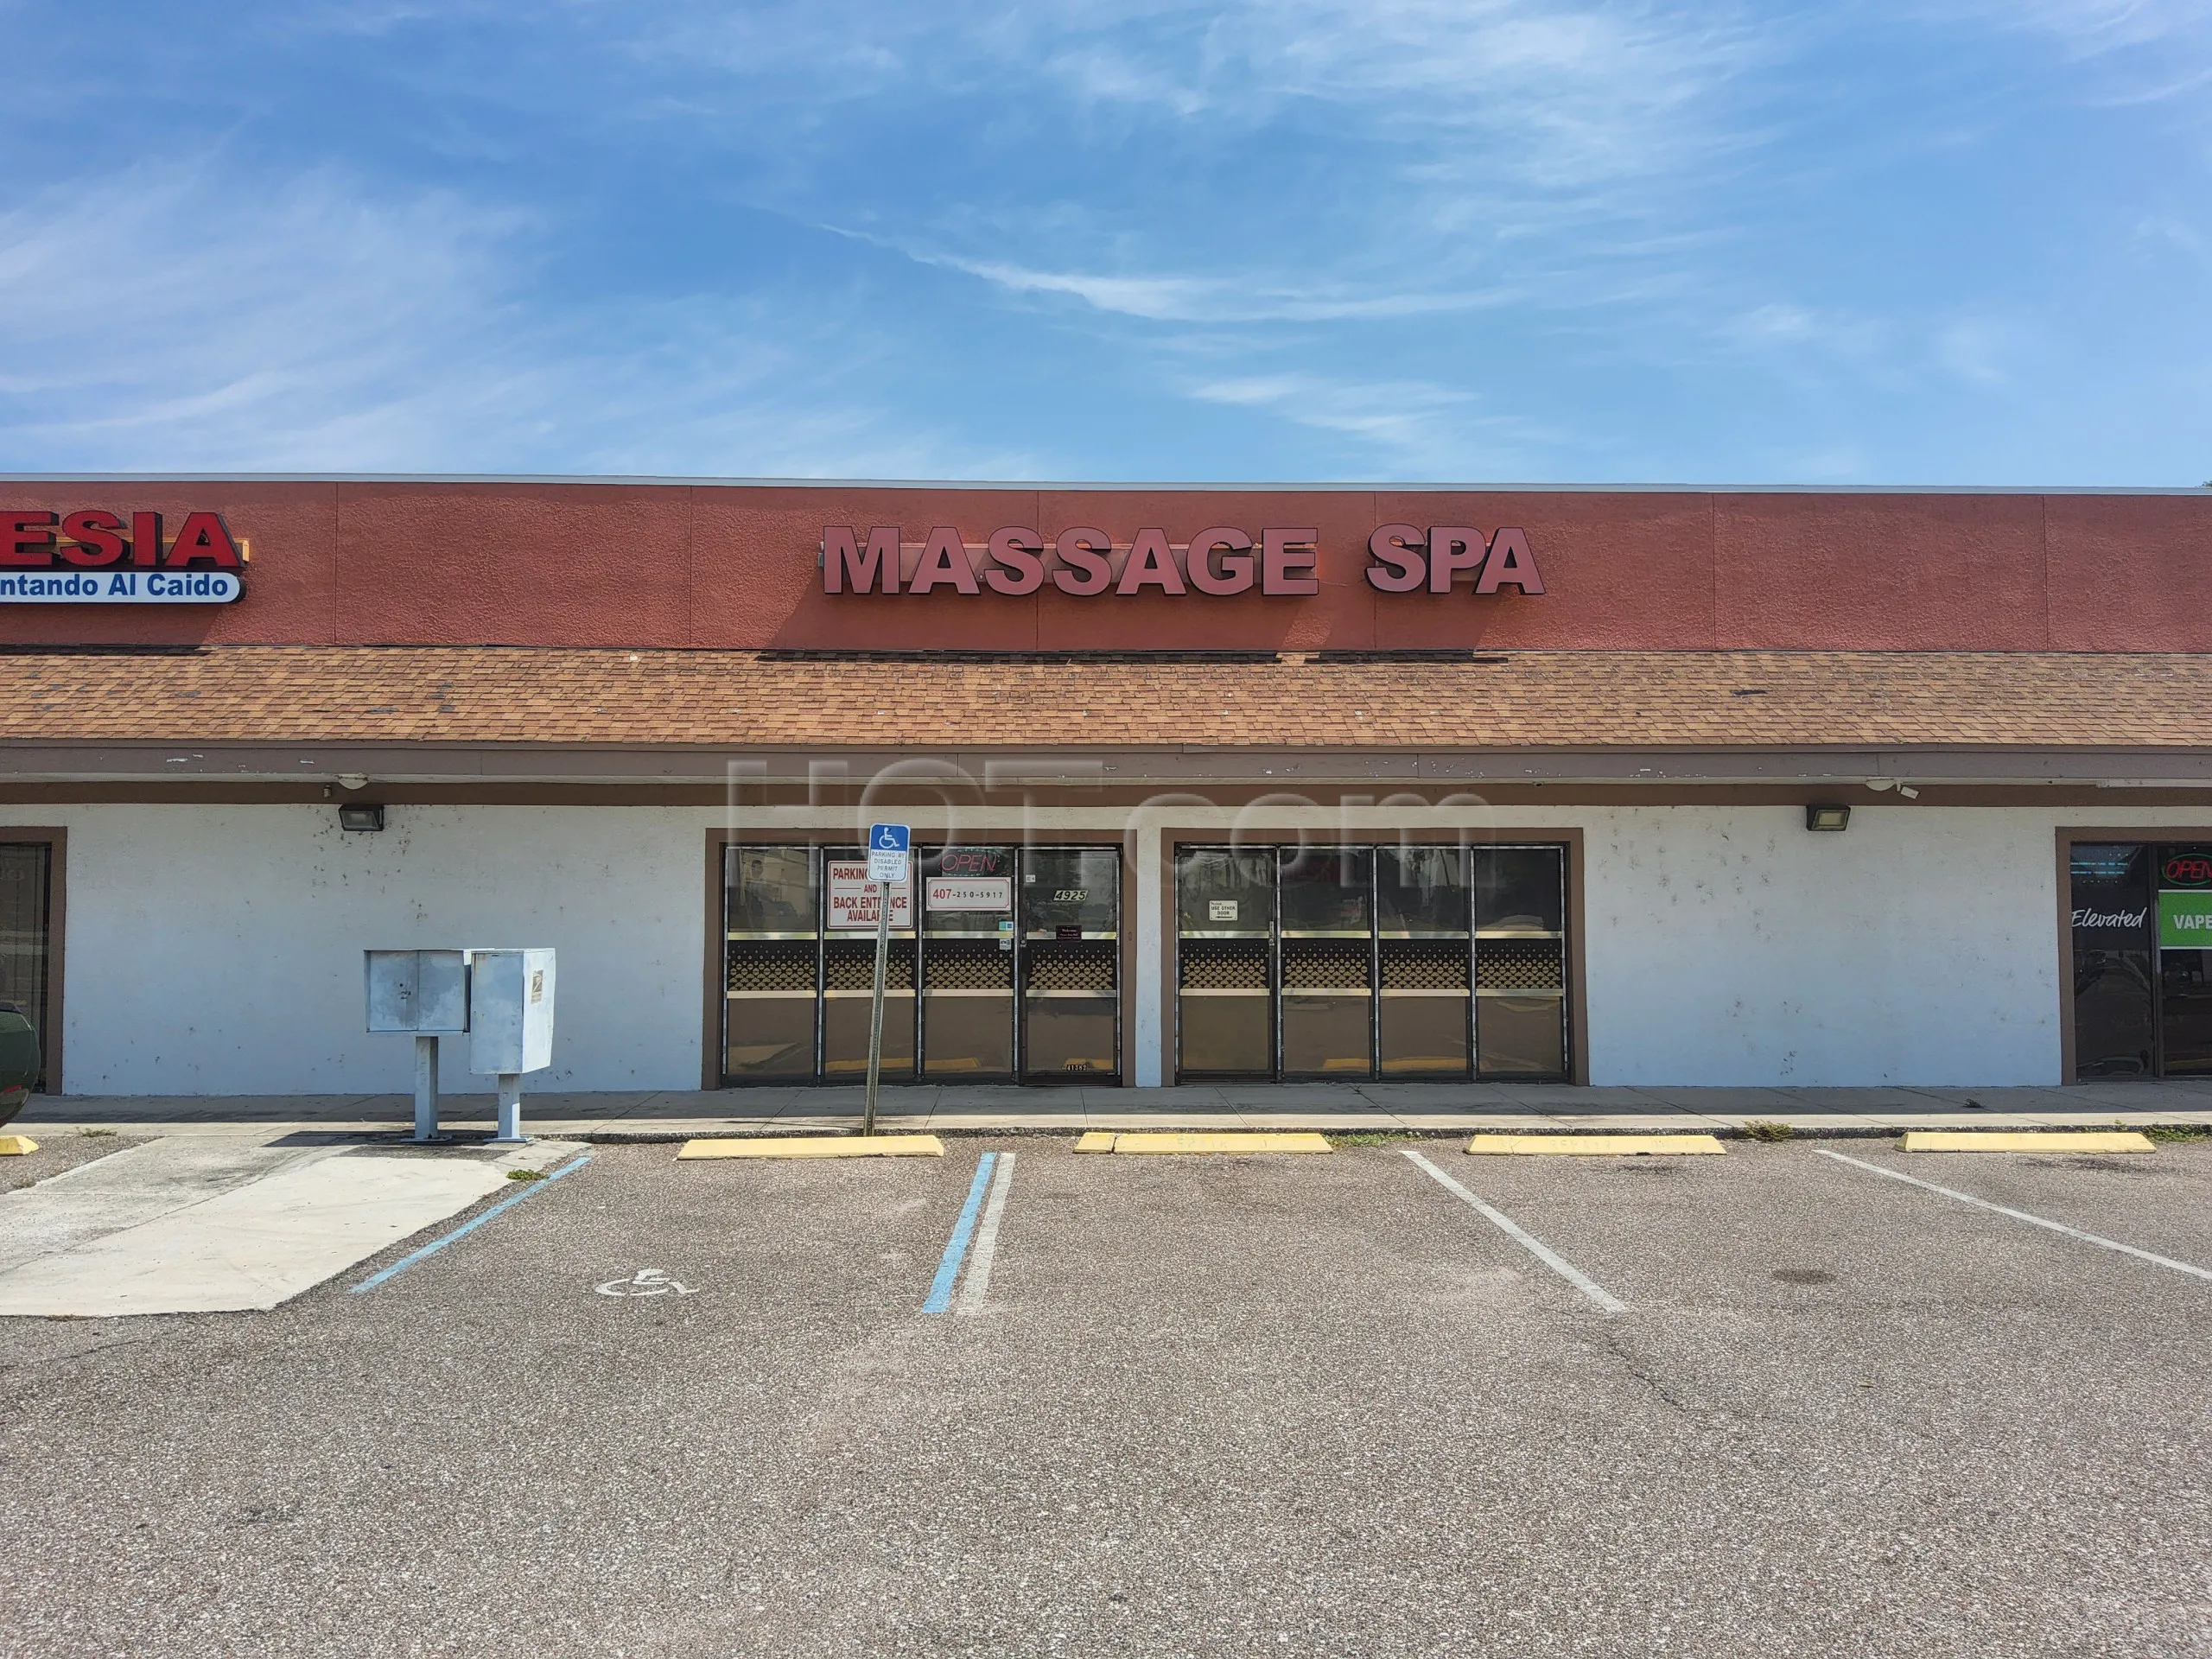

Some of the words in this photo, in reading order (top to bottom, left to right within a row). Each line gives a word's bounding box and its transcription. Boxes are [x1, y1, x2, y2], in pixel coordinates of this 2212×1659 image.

[0, 510, 245, 567] ESIA
[822, 524, 1319, 596] MASSAGE
[1364, 523, 1547, 595] SPA
[1, 574, 99, 596] ntando
[108, 574, 136, 596] Al
[147, 574, 228, 596] Caido
[941, 854, 997, 872] OPEN
[864, 884, 877, 893] AND
[1055, 891, 1086, 900] 4925
[833, 896, 858, 908] BACK
[860, 896, 907, 908] ENTNCE
[847, 909, 893, 922] AVAILAE
[2071, 907, 2148, 928] Elevated
